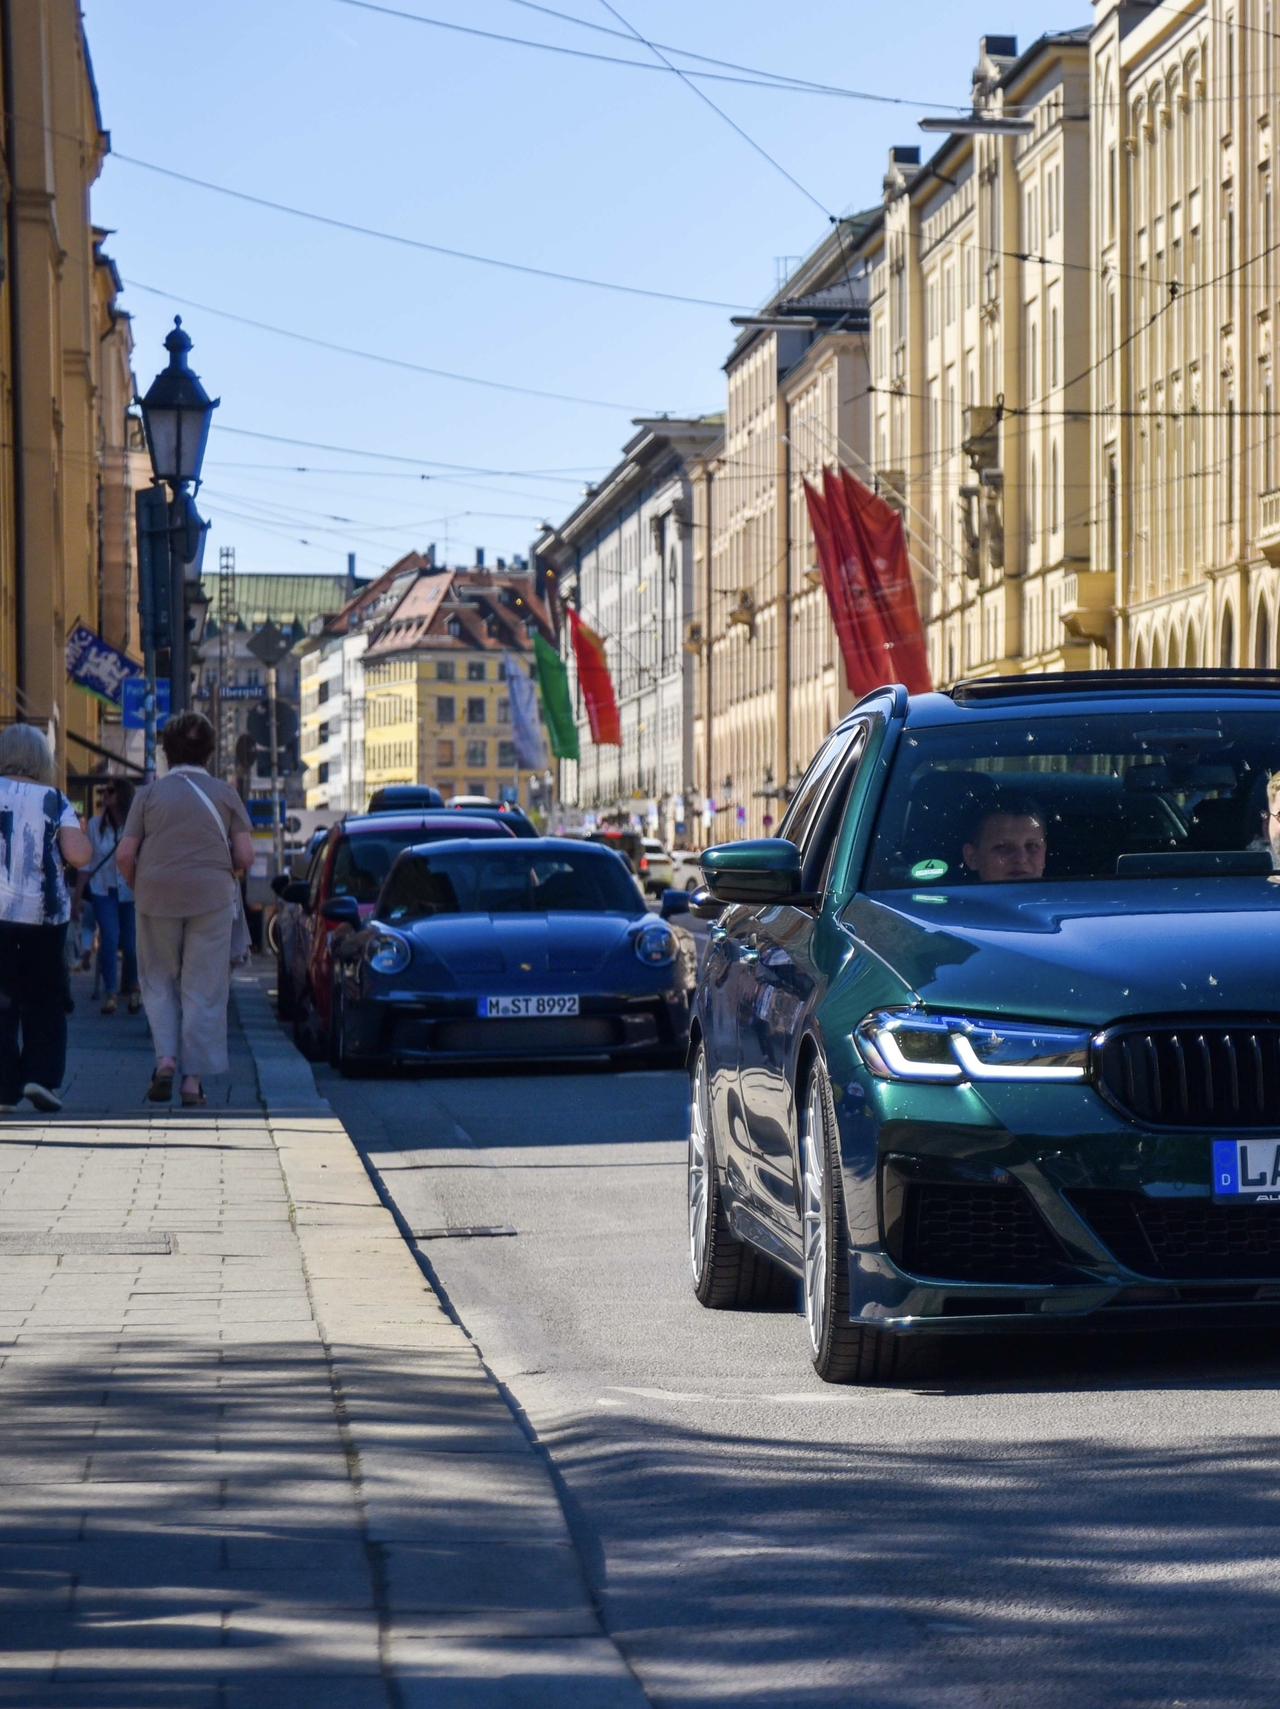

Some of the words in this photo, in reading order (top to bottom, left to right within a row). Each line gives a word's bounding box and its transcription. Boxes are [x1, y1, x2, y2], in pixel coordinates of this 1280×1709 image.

[924, 859, 935, 869] 4
[489, 999, 500, 1015] M
[511, 998, 532, 1014] ST
[536, 997, 577, 1014] 8992
[1221, 1174, 1231, 1186] D
